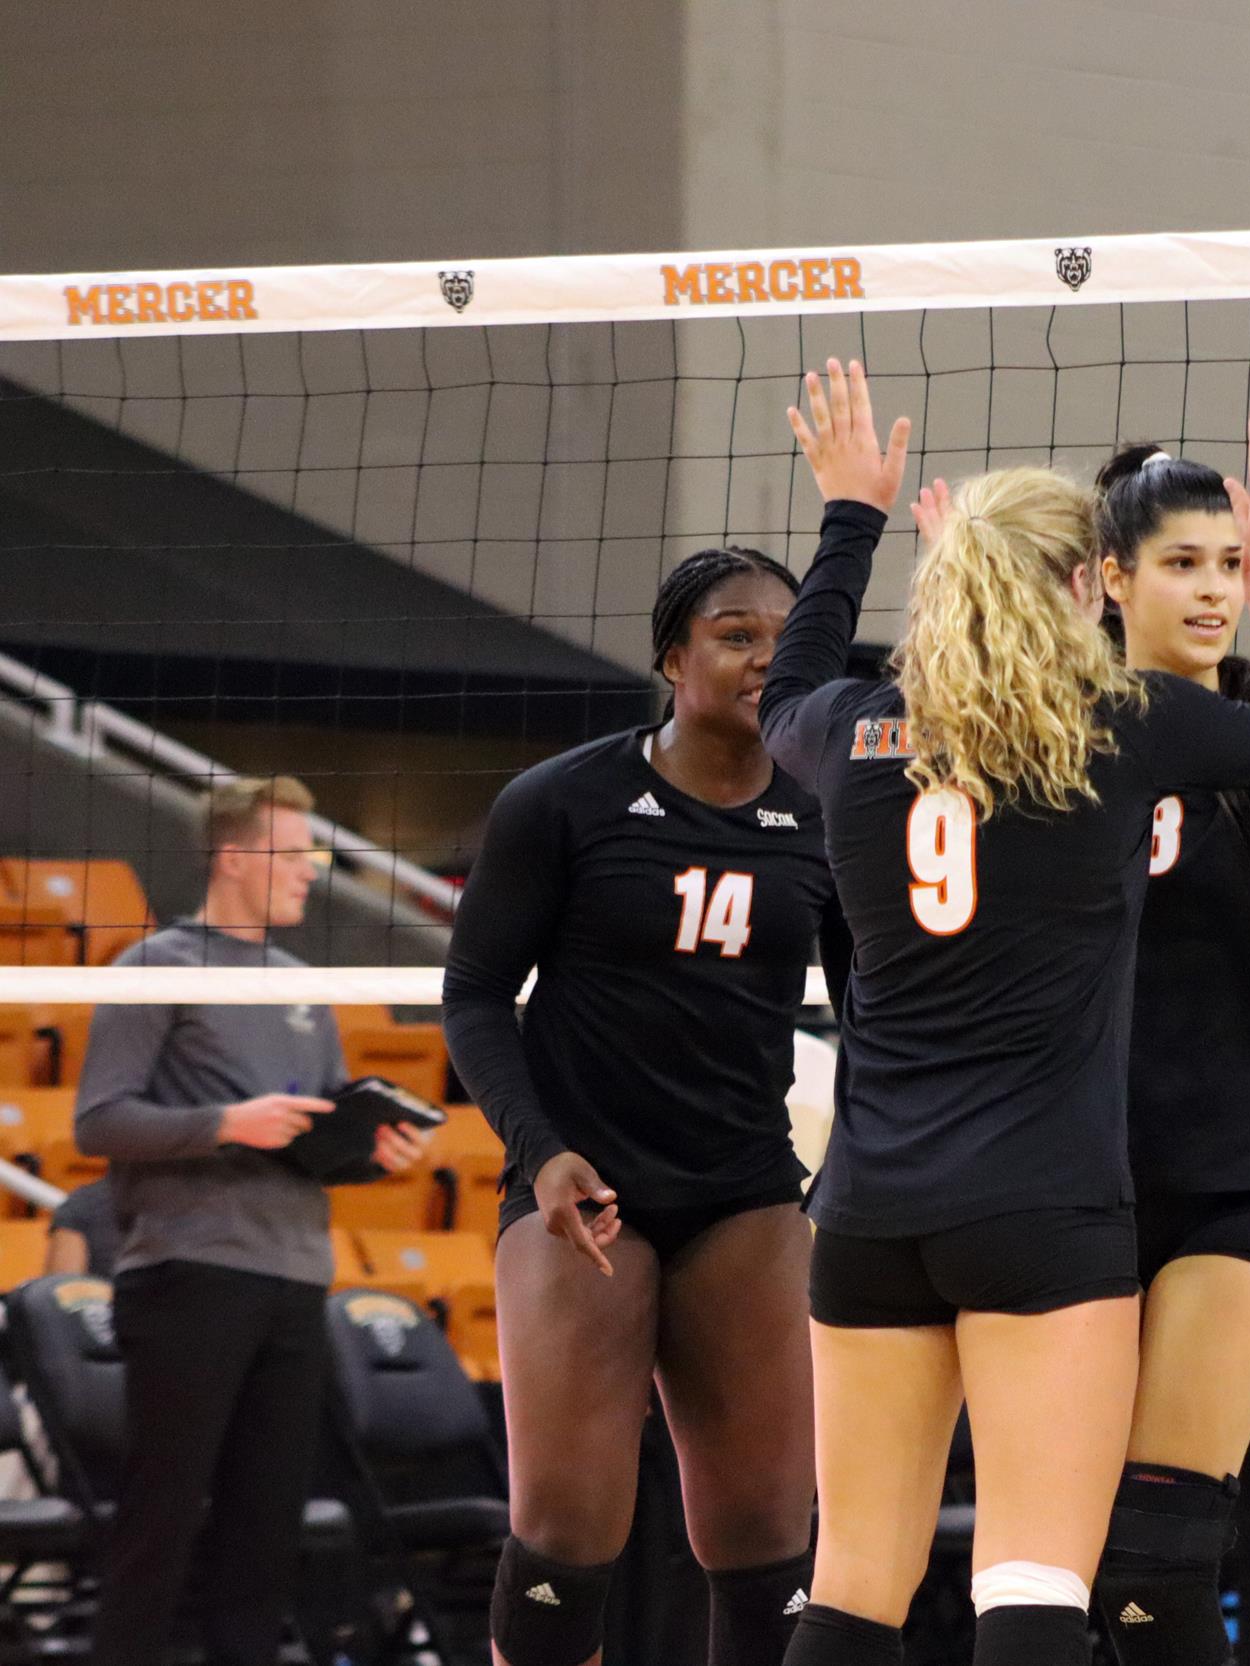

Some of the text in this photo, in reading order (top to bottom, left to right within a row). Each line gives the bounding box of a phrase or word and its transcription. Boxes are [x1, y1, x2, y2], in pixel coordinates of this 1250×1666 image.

[63, 279, 259, 326] MERCER
[660, 257, 866, 306] MERCER
[906, 784, 978, 936] 9
[673, 865, 754, 958] 14
